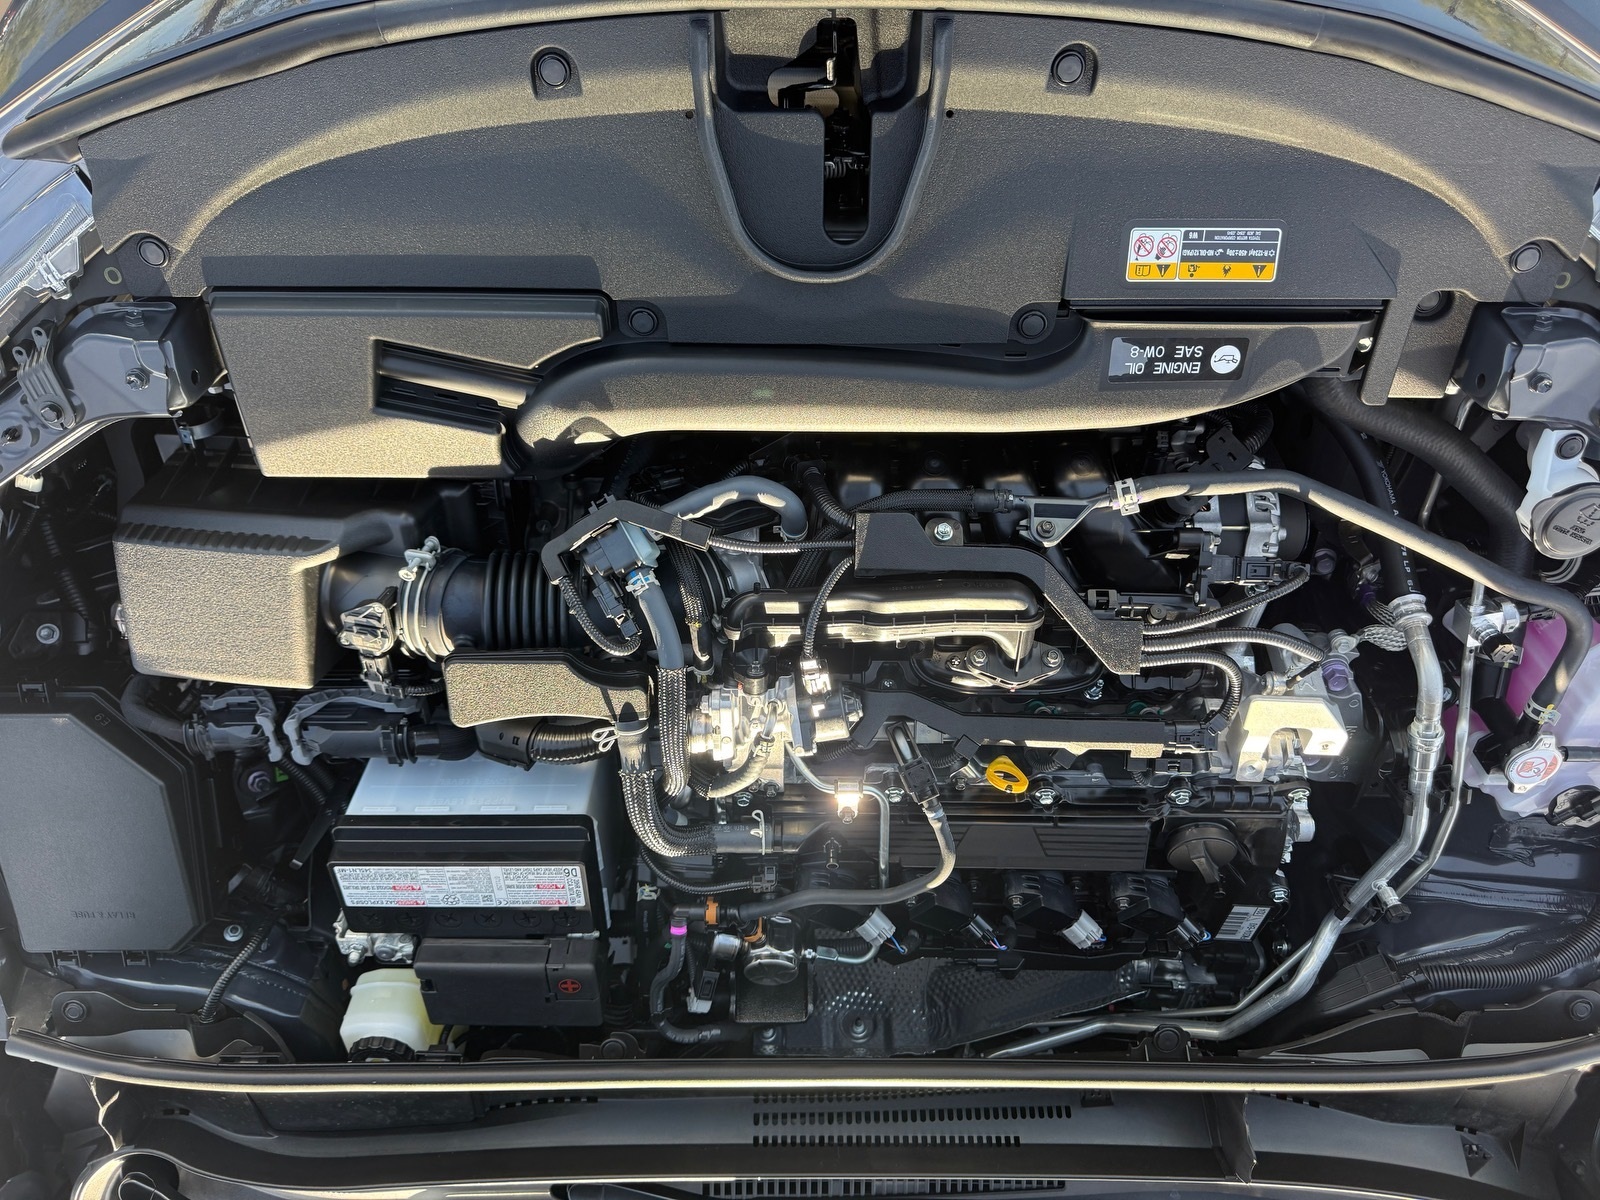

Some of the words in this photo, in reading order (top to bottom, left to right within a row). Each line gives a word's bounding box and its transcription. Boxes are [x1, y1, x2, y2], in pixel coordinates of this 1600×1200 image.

[1130, 346, 1165, 358] 0W-8
[1174, 346, 1204, 358] SAE
[1125, 362, 1145, 374] OIL
[1153, 362, 1201, 374] ENGINE
[1380, 470, 1396, 504] YOKOHAMA
[1403, 560, 1410, 573] LP
[564, 868, 577, 877] D6
